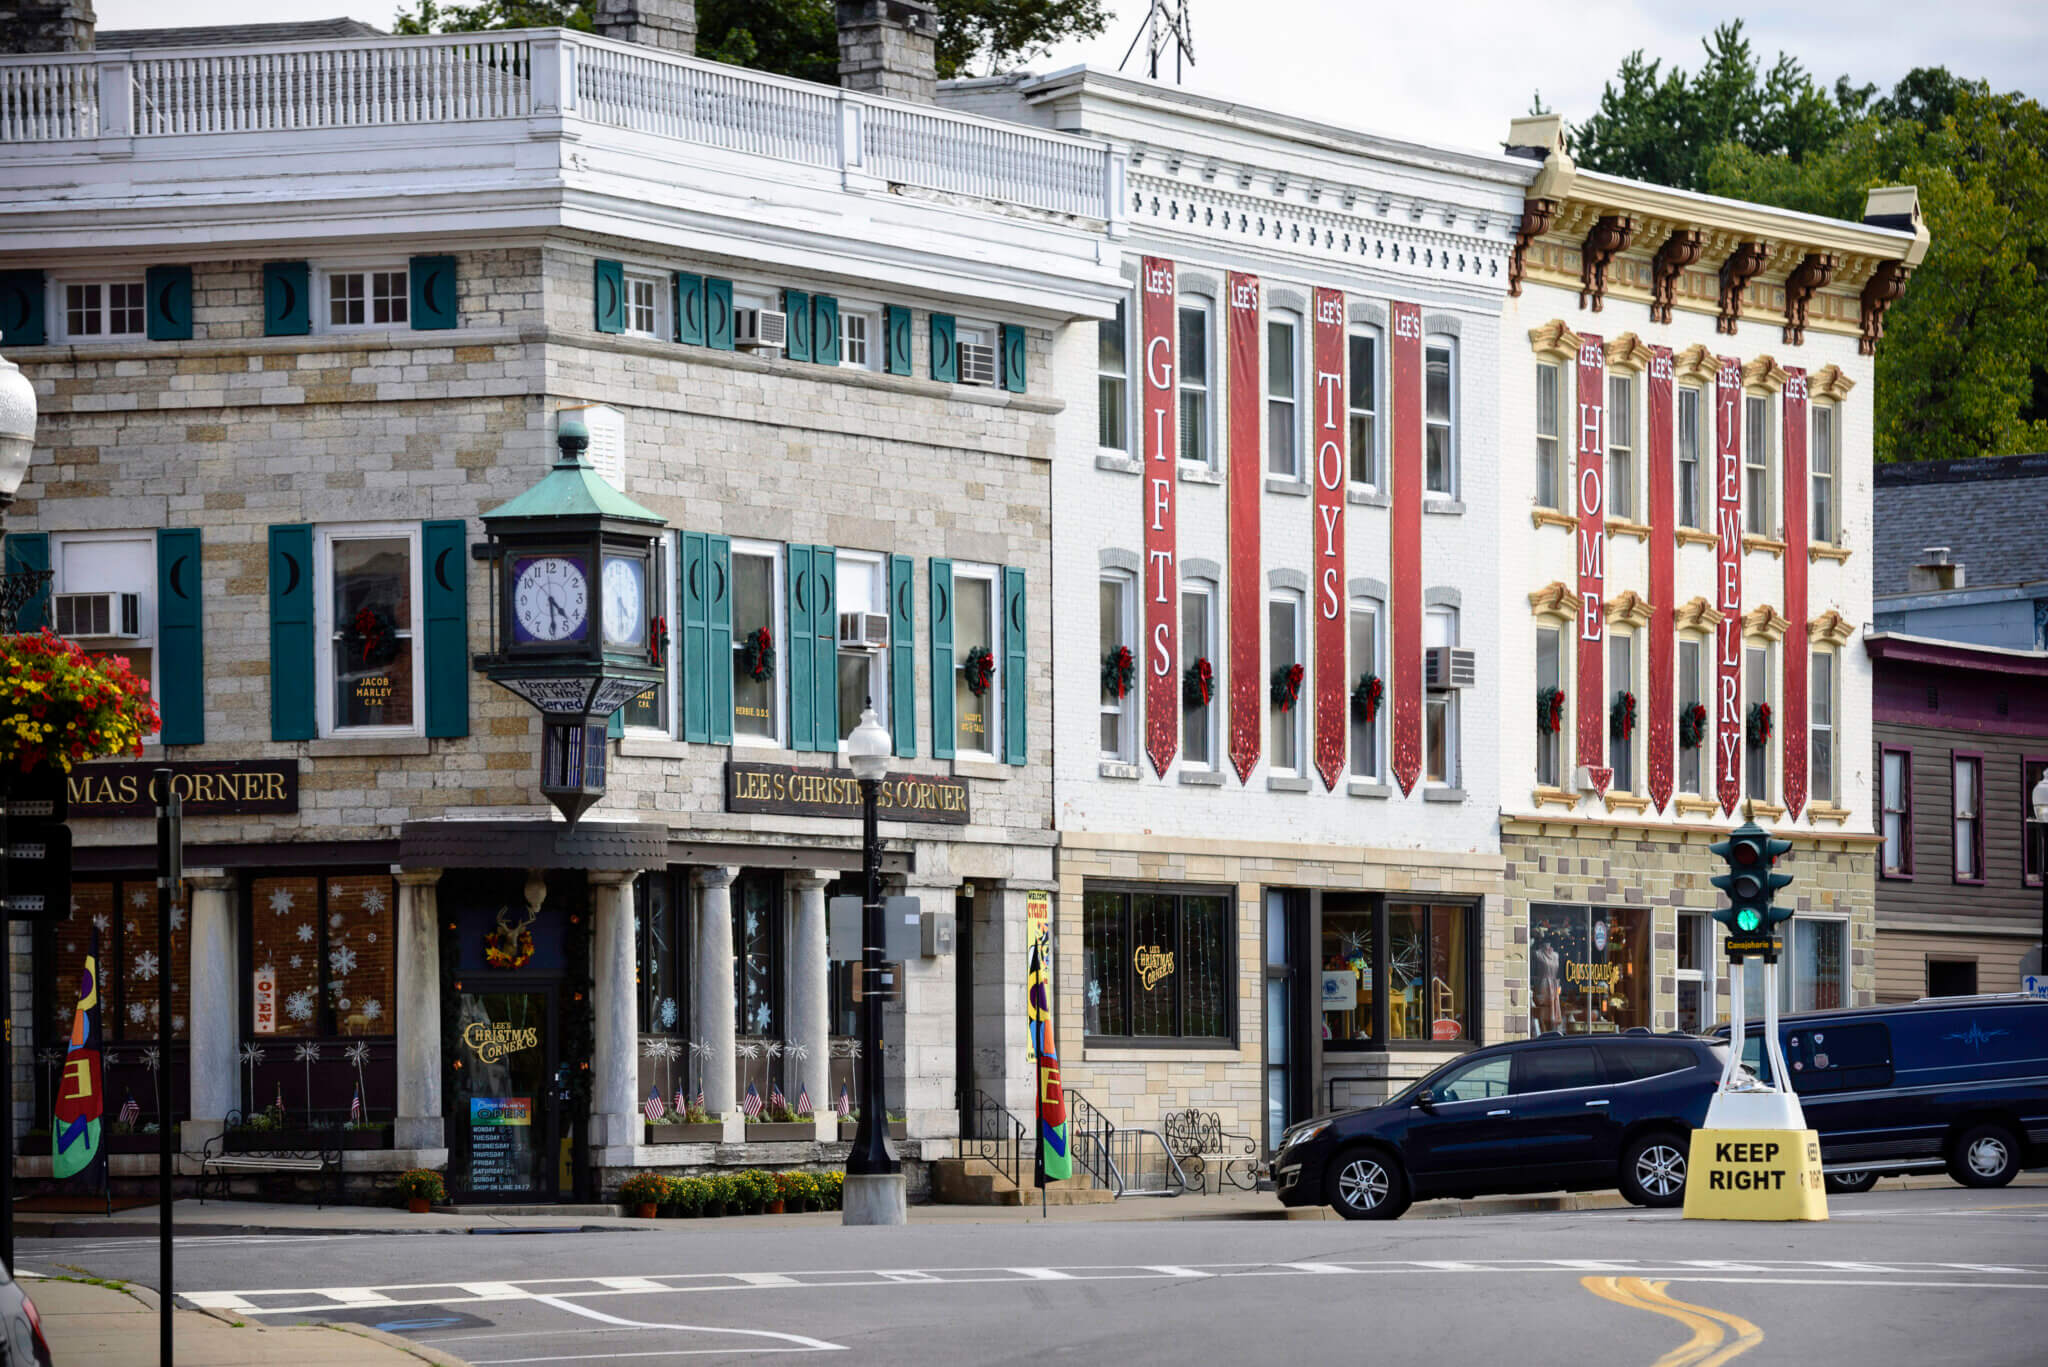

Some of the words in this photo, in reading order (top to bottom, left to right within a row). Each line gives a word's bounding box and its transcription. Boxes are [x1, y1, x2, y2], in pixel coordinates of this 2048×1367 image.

[1145, 264, 1173, 296] LEE'S
[1231, 280, 1257, 310] LEE'S
[1317, 295, 1342, 325] LEE'S
[1395, 309, 1419, 339] LEE'S
[1580, 344, 1602, 368] LEE'S
[1651, 355, 1673, 380] LEE'S
[1719, 365, 1740, 390] LEE'S
[1785, 375, 1807, 399] LEE'S
[1147, 335, 1173, 676] GIFTS
[1318, 370, 1343, 620] TOYS
[1579, 403, 1603, 641] HOME
[545, 562, 557, 573] 12
[524, 577, 534, 589] 10
[571, 577, 579, 588] 2
[1718, 401, 1742, 782] JEWELRY
[576, 593, 583, 604] 3
[524, 611, 531, 621] 8
[562, 620, 569, 632] 5
[571, 609, 580, 620] 4
[534, 621, 541, 632] 7
[518, 679, 582, 691] Honoring
[528, 689, 548, 698] All
[555, 688, 583, 698] Who
[537, 699, 584, 711] Served
[67, 776, 138, 803] MAS
[896, 781, 967, 811] CORNER
[1028, 903, 1048, 919] CYCLISTS
[1134, 945, 1175, 974] CHRISTMAS
[462, 1022, 538, 1048] CHRISTMAS
[477, 1041, 527, 1064] CORNER
[478, 1108, 528, 1119] OPEN
[1716, 1143, 1779, 1162] KEEP
[1709, 1170, 1786, 1190] RIGHT
